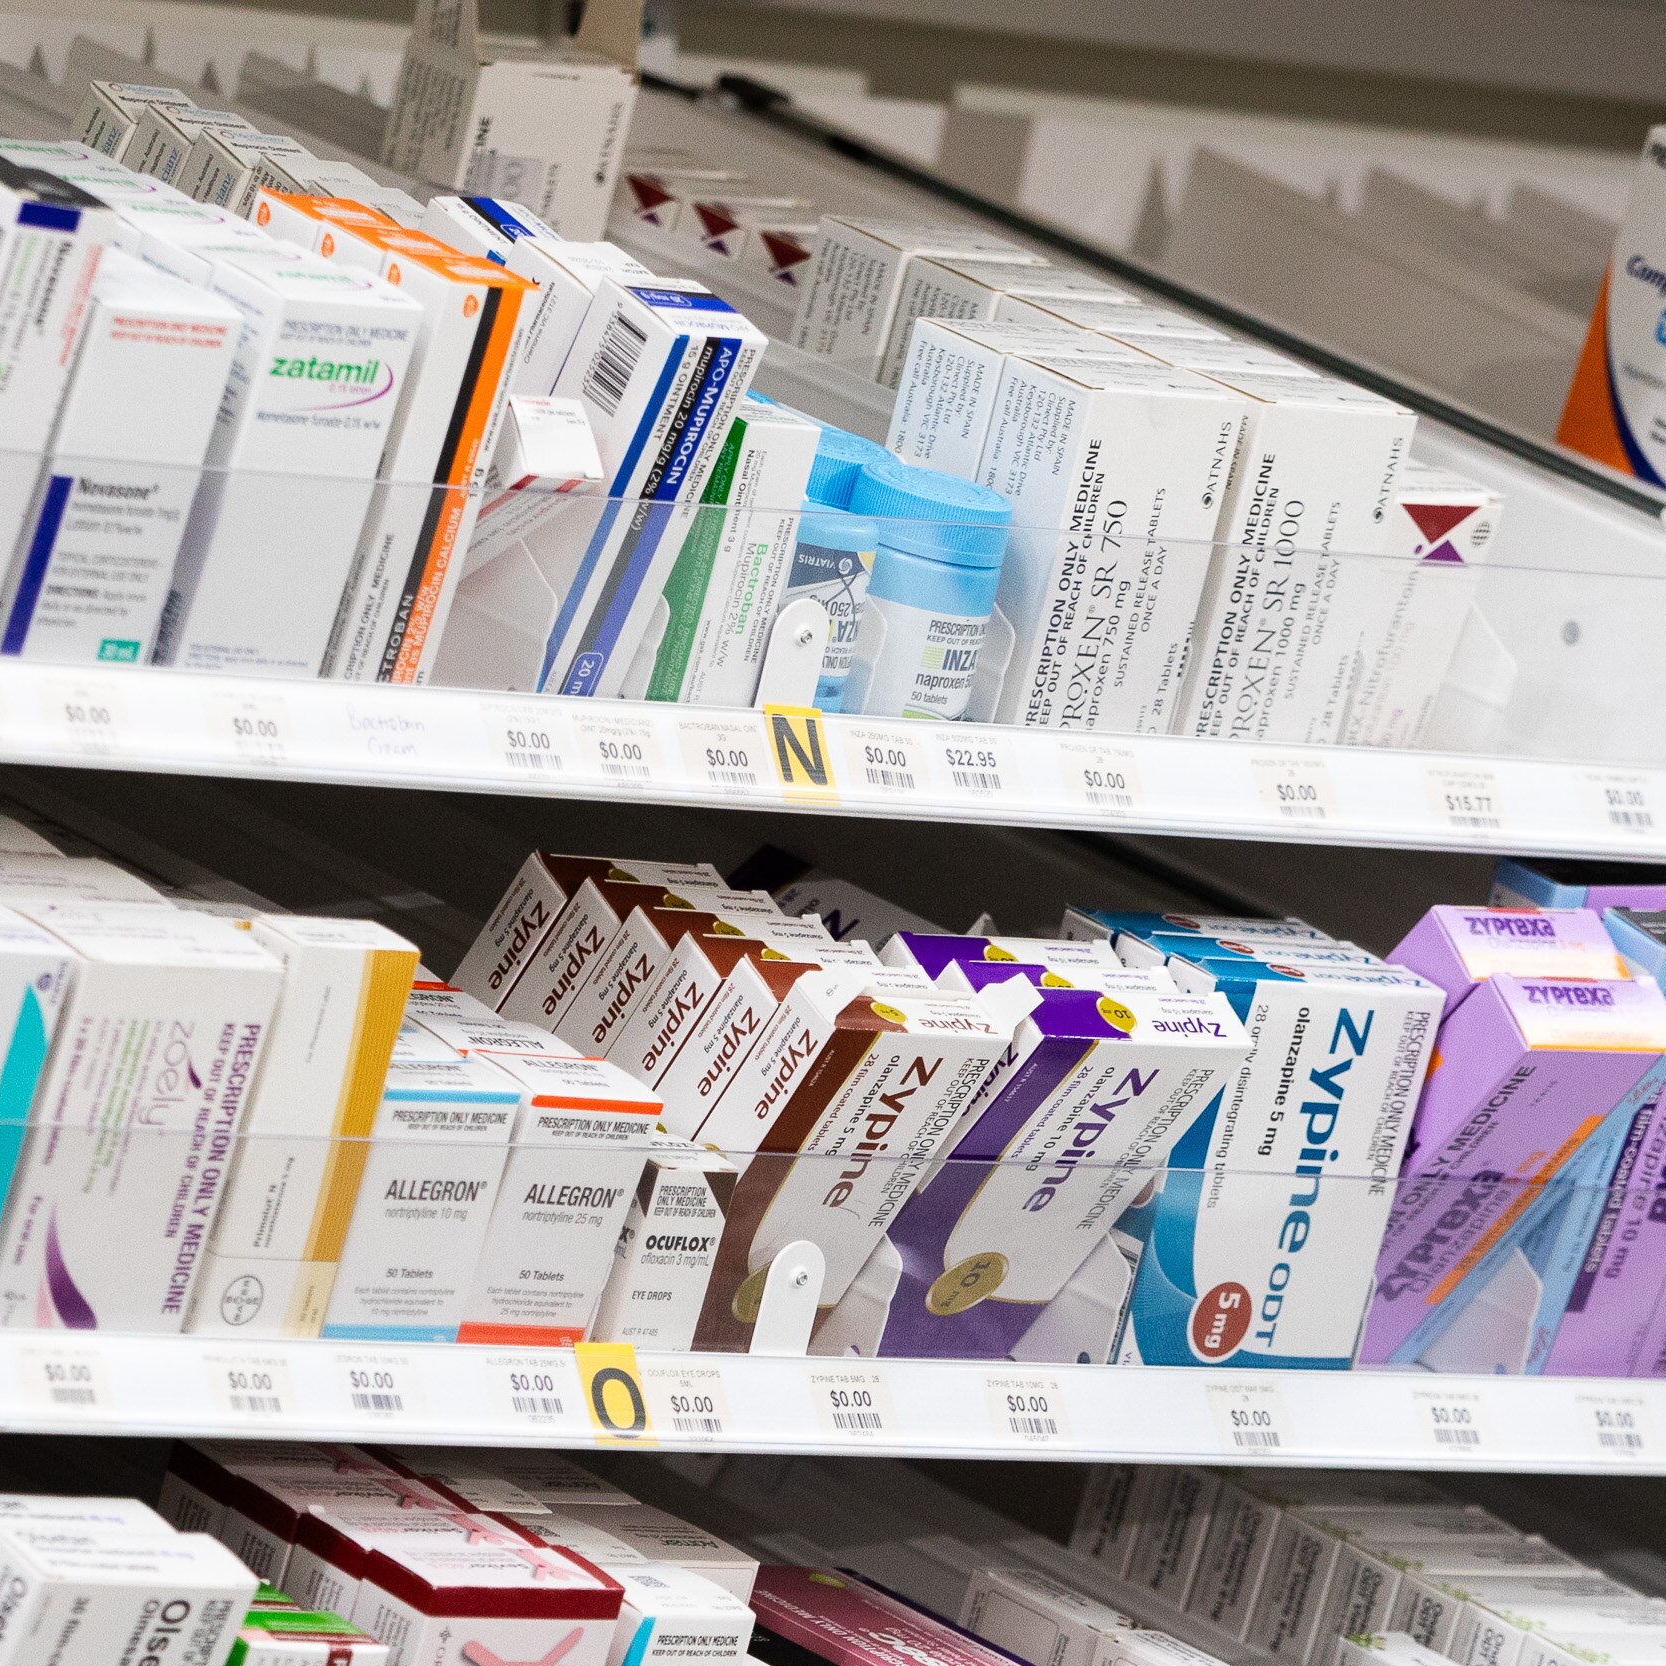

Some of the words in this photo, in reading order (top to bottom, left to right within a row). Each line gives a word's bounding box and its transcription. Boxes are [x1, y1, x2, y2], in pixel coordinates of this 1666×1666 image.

[270, 356, 380, 385] zatamil
[682, 347, 713, 410] mupirocin
[653, 374, 687, 440] OINTMENT
[667, 347, 733, 485] APO-MUPIROCIN
[675, 412, 687, 429] 20
[655, 431, 677, 467] mg/g
[742, 450, 755, 481] Nasal
[1206, 421, 1233, 492] ATNAHS
[1058, 541, 1079, 592] ONLY
[1069, 439, 1103, 532] MEDICINE
[1101, 500, 1128, 554] 750
[1274, 500, 1305, 567] 1000
[436, 507, 462, 568] CALCIUM
[732, 542, 756, 610] Mupirocin
[733, 543, 769, 635] Bactroban
[1091, 561, 1118, 600] SR
[1114, 612, 1140, 687] SUSTAINED
[1133, 550, 1154, 609] RELEASE
[1147, 488, 1166, 547] TABLETS
[1263, 574, 1290, 612] SR
[727, 612, 739, 634] 2%
[1102, 615, 1120, 646] 750
[1114, 580, 1132, 610] mg
[941, 649, 977, 671] INZA
[911, 692, 922, 700] 50
[923, 693, 947, 704] tablets
[915, 673, 965, 689] naproxen
[772, 713, 828, 785] N
[865, 746, 906, 767] $0.00
[946, 748, 996, 768] $22.95
[488, 901, 551, 990] Zypine
[592, 953, 655, 1044] Zypine
[1272, 1006, 1311, 1108] olanzapine
[209, 1024, 262, 1162] PRESCRIPTION
[849, 1054, 901, 1124] olanzapine
[927, 1058, 991, 1143] PRESCRIPTION
[1056, 1066, 1115, 1132] olanzapine
[1271, 1110, 1285, 1123] 5
[1446, 1066, 1537, 1155] MEDICINE
[823, 1056, 944, 1208] Zypine
[824, 1140, 845, 1157] mg
[843, 1126, 855, 1136] 5
[1022, 1067, 1161, 1213] Zypine
[1044, 1128, 1062, 1150] 10
[1257, 1125, 1281, 1158] mg
[1277, 1007, 1375, 1255] Zypine
[909, 1141, 936, 1170] ONLY
[1025, 1154, 1042, 1172] mg
[194, 1168, 220, 1217] ONLY
[657, 1195, 674, 1207] ONLY
[676, 1196, 707, 1208] MEDICINE
[660, 1185, 707, 1197] PRESCRIPTION
[868, 1172, 915, 1228] MEDICINE
[522, 1211, 574, 1225] nortriptyline
[575, 1214, 586, 1224] 25
[588, 1215, 603, 1227] mg
[162, 1223, 205, 1315] MEDICINE
[386, 1269, 398, 1279] 50
[400, 1269, 433, 1280] Tablets
[519, 1270, 531, 1280] 50
[533, 1271, 564, 1282] Tablets
[641, 1252, 675, 1266] ofloxacin
[676, 1254, 682, 1265] 3
[683, 1254, 709, 1267] mg/mL
[632, 1290, 646, 1300] EYE
[648, 1291, 672, 1301] DROPS
[1218, 1291, 1242, 1310] 5
[1254, 1262, 1291, 1348] ODT
[1203, 1312, 1228, 1349] mg
[510, 1374, 553, 1392] $0.00
[591, 1367, 646, 1439] O
[671, 1395, 714, 1414] $0.00
[657, 1635, 697, 1646] PRESCRIPTION
[698, 1636, 712, 1646] ONLY
[713, 1636, 739, 1647] MEDICINE
